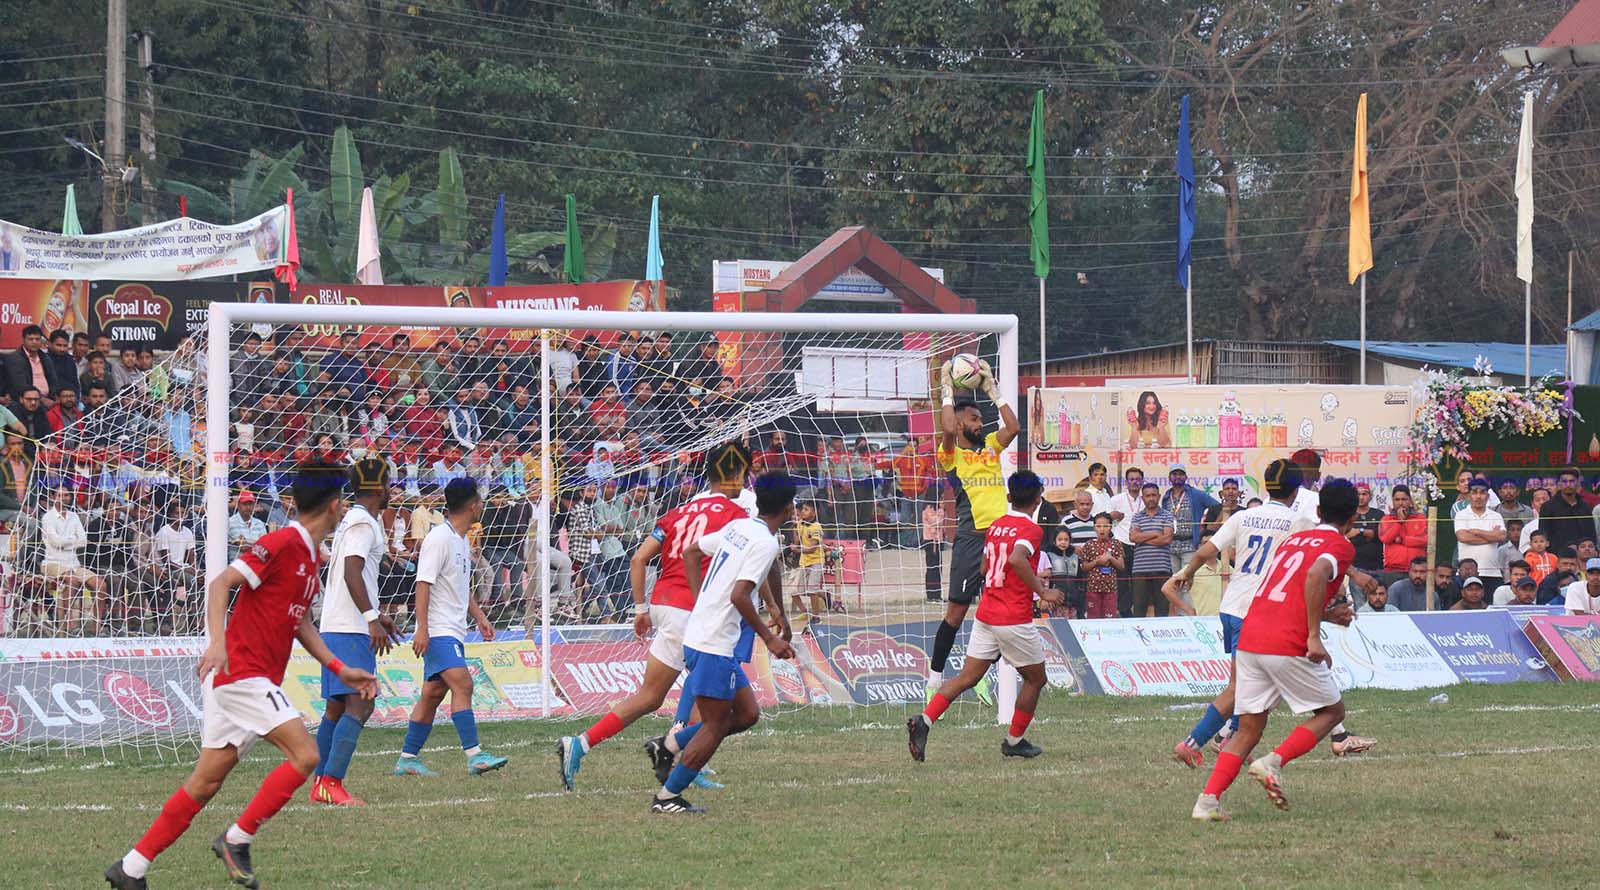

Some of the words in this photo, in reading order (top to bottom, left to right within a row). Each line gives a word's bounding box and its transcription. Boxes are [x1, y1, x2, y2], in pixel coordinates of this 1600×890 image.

[185, 300, 201, 309] FEEL
[319, 289, 346, 305] REAL
[1, 303, 22, 325] 8%
[105, 299, 140, 319] Nepal
[143, 300, 161, 316] Ice
[185, 309, 210, 321] EXTR
[111, 326, 156, 342] STRONG
[989, 525, 1018, 537] TAFC
[1241, 534, 1274, 575] 21
[703, 548, 730, 592] 17
[1255, 550, 1305, 602] 12
[303, 574, 316, 600] 11
[454, 644, 462, 657] 6
[1428, 632, 1457, 648] Your
[1455, 632, 1495, 649] Safety
[843, 649, 888, 670] Nepal
[892, 649, 917, 668] Ice
[1446, 651, 1458, 666] is
[1459, 655, 1480, 666] our
[1476, 649, 1522, 666] Priority.
[1131, 660, 1188, 684] IRMITA
[1181, 658, 1232, 682] TRADIN
[166, 680, 204, 720] L
[266, 690, 290, 712] 11
[865, 682, 926, 702] STRONG
[15, 682, 105, 727] LG
